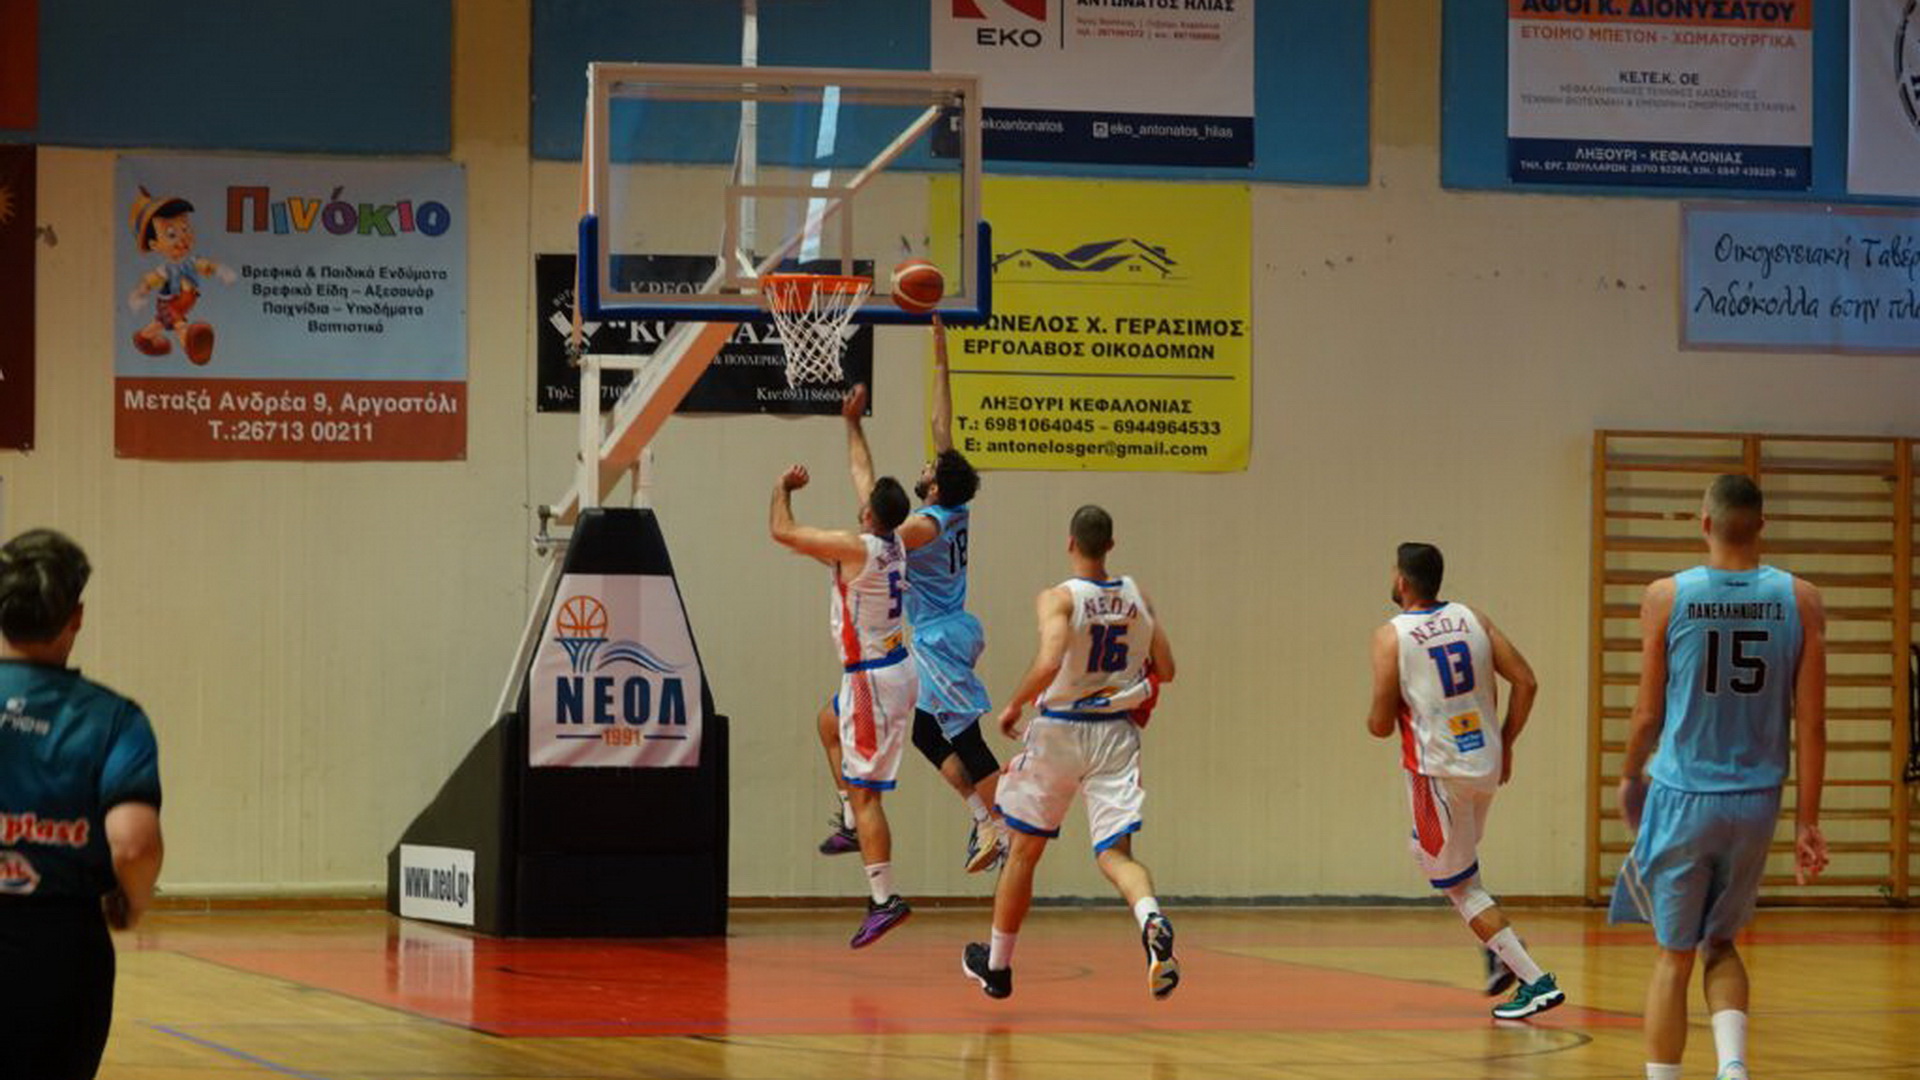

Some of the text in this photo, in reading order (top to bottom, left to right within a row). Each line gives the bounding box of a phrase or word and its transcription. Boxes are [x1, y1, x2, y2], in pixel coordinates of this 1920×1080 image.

[1629, 0, 1796, 22] ΔΙΟΝΥΣΑΤΟΥ
[977, 28, 1042, 48] EKO
[1521, 26, 1584, 40] ΕΤΟΙΜΟ
[1589, 28, 1658, 43] ΜΠΕΤΟΝ
[1674, 32, 1796, 47] ΧΩΜΑΤΟΥΡΓΙΚΑ
[1576, 148, 1637, 161] ΛΗΞΟΥΡΙ
[1650, 149, 1743, 164] ΚΕΦΑΛΟΝΙΑΣ
[226, 185, 451, 237] Πινόκιο
[1714, 233, 1850, 280] Οικογενειακή
[241, 264, 448, 281] Βρεφικά & Παιδικά Ενδύματα
[252, 283, 312, 300] Βρεφικά
[316, 283, 349, 299] Είδη
[364, 283, 434, 300] Αξεσουάρ
[1694, 280, 1819, 318] Λαδόκολλα
[263, 301, 330, 317] Παιχνίδια
[346, 302, 424, 318] Υποδήματα
[308, 320, 384, 334] Βαπτιστικά
[945, 314, 1244, 337] ΩΝΕΛΟΣ Χ. ΓΕΡΑΣΙΜΟΣ
[964, 339, 1215, 360] ΕΡΓΟΛΑΒΟΣ ΟΙΚΟΔΟΜΩΝ
[124, 389, 457, 417] Μεταξά Ανδρέα 9, Αργοστόλι
[980, 396, 1193, 414] ΛΗΞΟΥΡΙ ΚΕΦΑΛΟΝΙΑΣ
[208, 420, 374, 442] Τ.:26713 00211
[957, 416, 979, 431] Τ.:
[984, 417, 1095, 433] 6981064045
[1113, 420, 1221, 435] 6944964533
[987, 439, 1208, 458] antonelosger@gmail.com
[948, 528, 968, 574] 18
[888, 570, 903, 620] 5
[1410, 618, 1470, 645] ΝΕΟΛ
[1087, 624, 1129, 673] 16
[1428, 640, 1477, 698] 13
[1705, 630, 1770, 695] 15
[556, 676, 687, 726] ΝΕΟΛ
[602, 728, 642, 748] 1991
[404, 864, 470, 908] www.neol.gr
